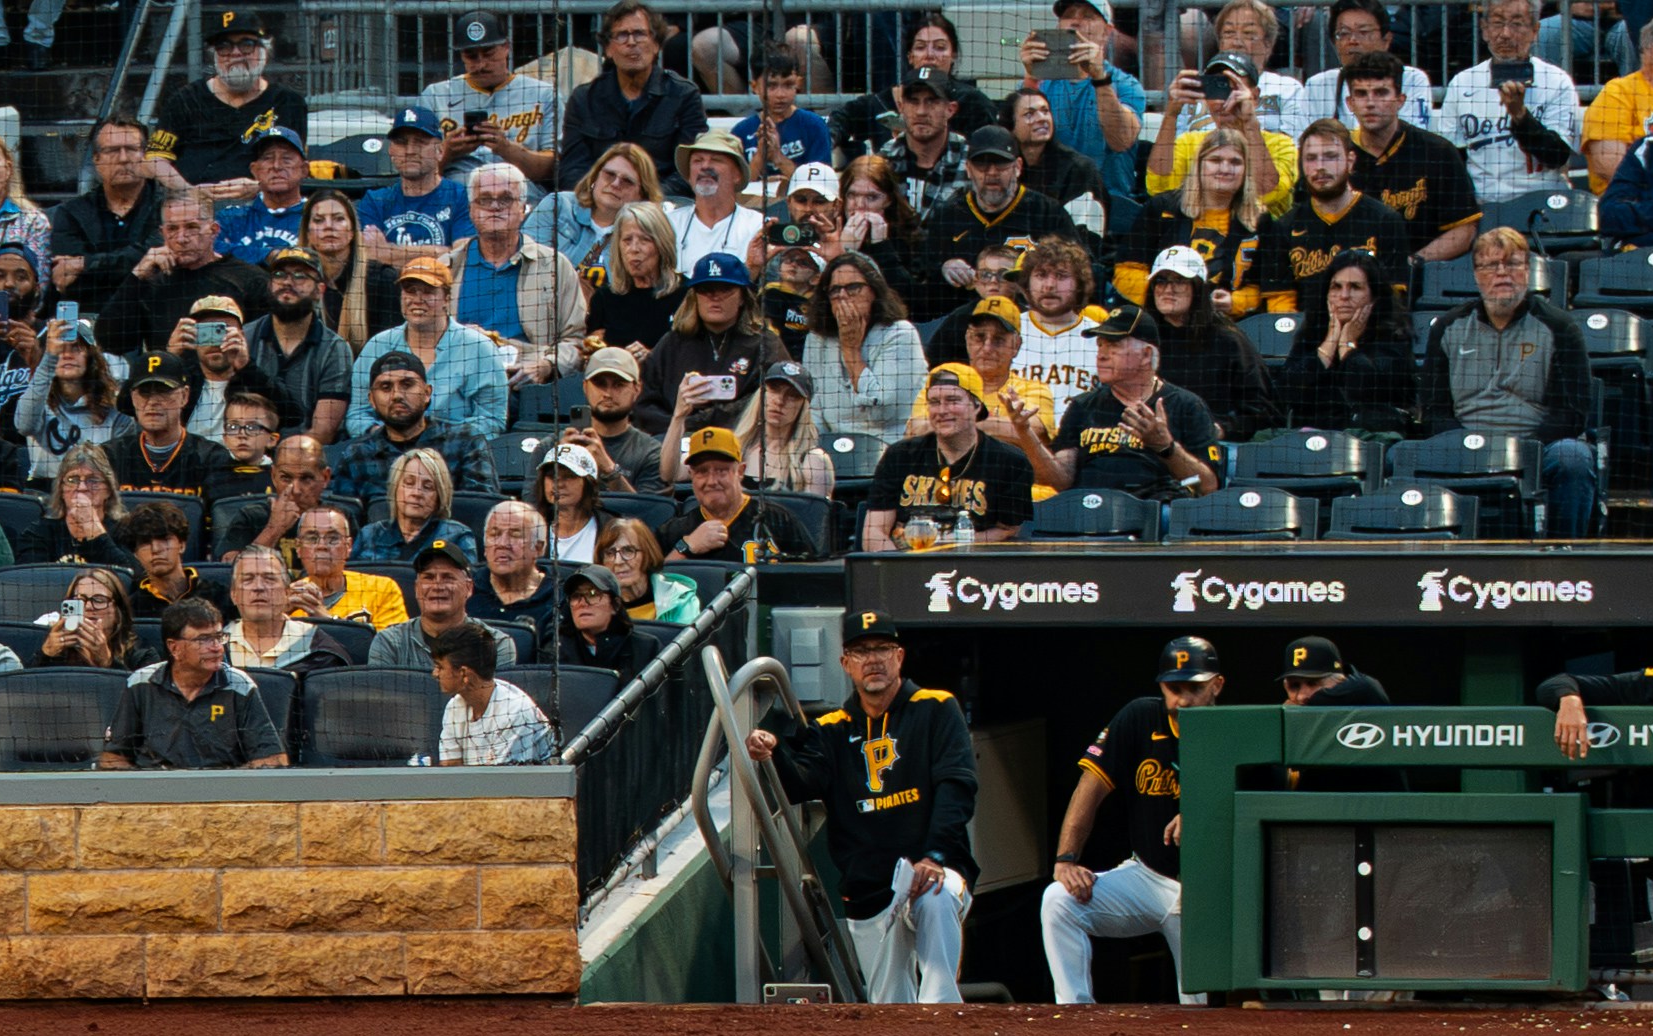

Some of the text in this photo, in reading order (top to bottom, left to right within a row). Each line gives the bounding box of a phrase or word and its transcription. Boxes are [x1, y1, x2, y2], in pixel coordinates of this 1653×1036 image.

[222, 11, 235, 27] P
[808, 168, 820, 181] P
[708, 260, 721, 276] LA
[988, 300, 1001, 311] P
[1520, 342, 1535, 361] P
[147, 357, 161, 373] P
[702, 430, 714, 444] P
[956, 575, 1099, 610] Cygames
[1202, 575, 1345, 610] Cygames
[1447, 576, 1592, 610] Cygames
[862, 612, 876, 629] P
[1176, 651, 1189, 669] P
[1292, 648, 1306, 666] P
[210, 705, 224, 721] P
[1393, 724, 1524, 747] HYUNDAI
[862, 737, 898, 792] P
[876, 787, 919, 810] PIRATES
